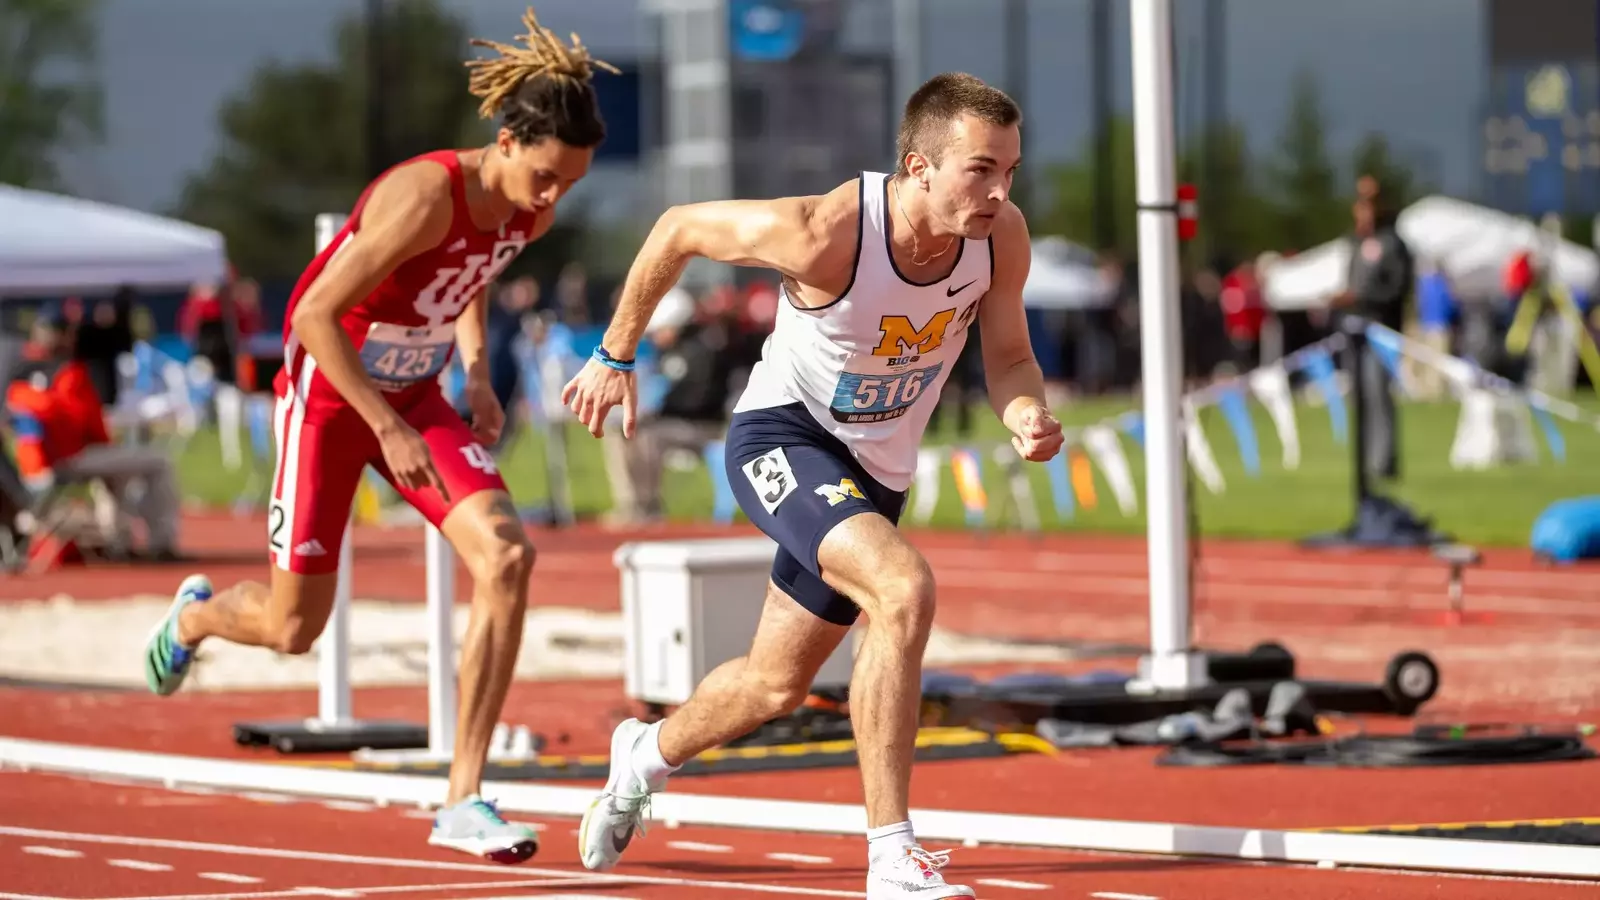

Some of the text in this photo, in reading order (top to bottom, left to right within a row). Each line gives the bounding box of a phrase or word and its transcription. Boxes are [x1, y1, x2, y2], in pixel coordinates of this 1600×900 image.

[872, 307, 957, 356] M
[375, 347, 436, 377] 425
[853, 371, 924, 409] 516
[752, 456, 788, 503] 3
[814, 478, 867, 507] M
[269, 504, 285, 549] 2
